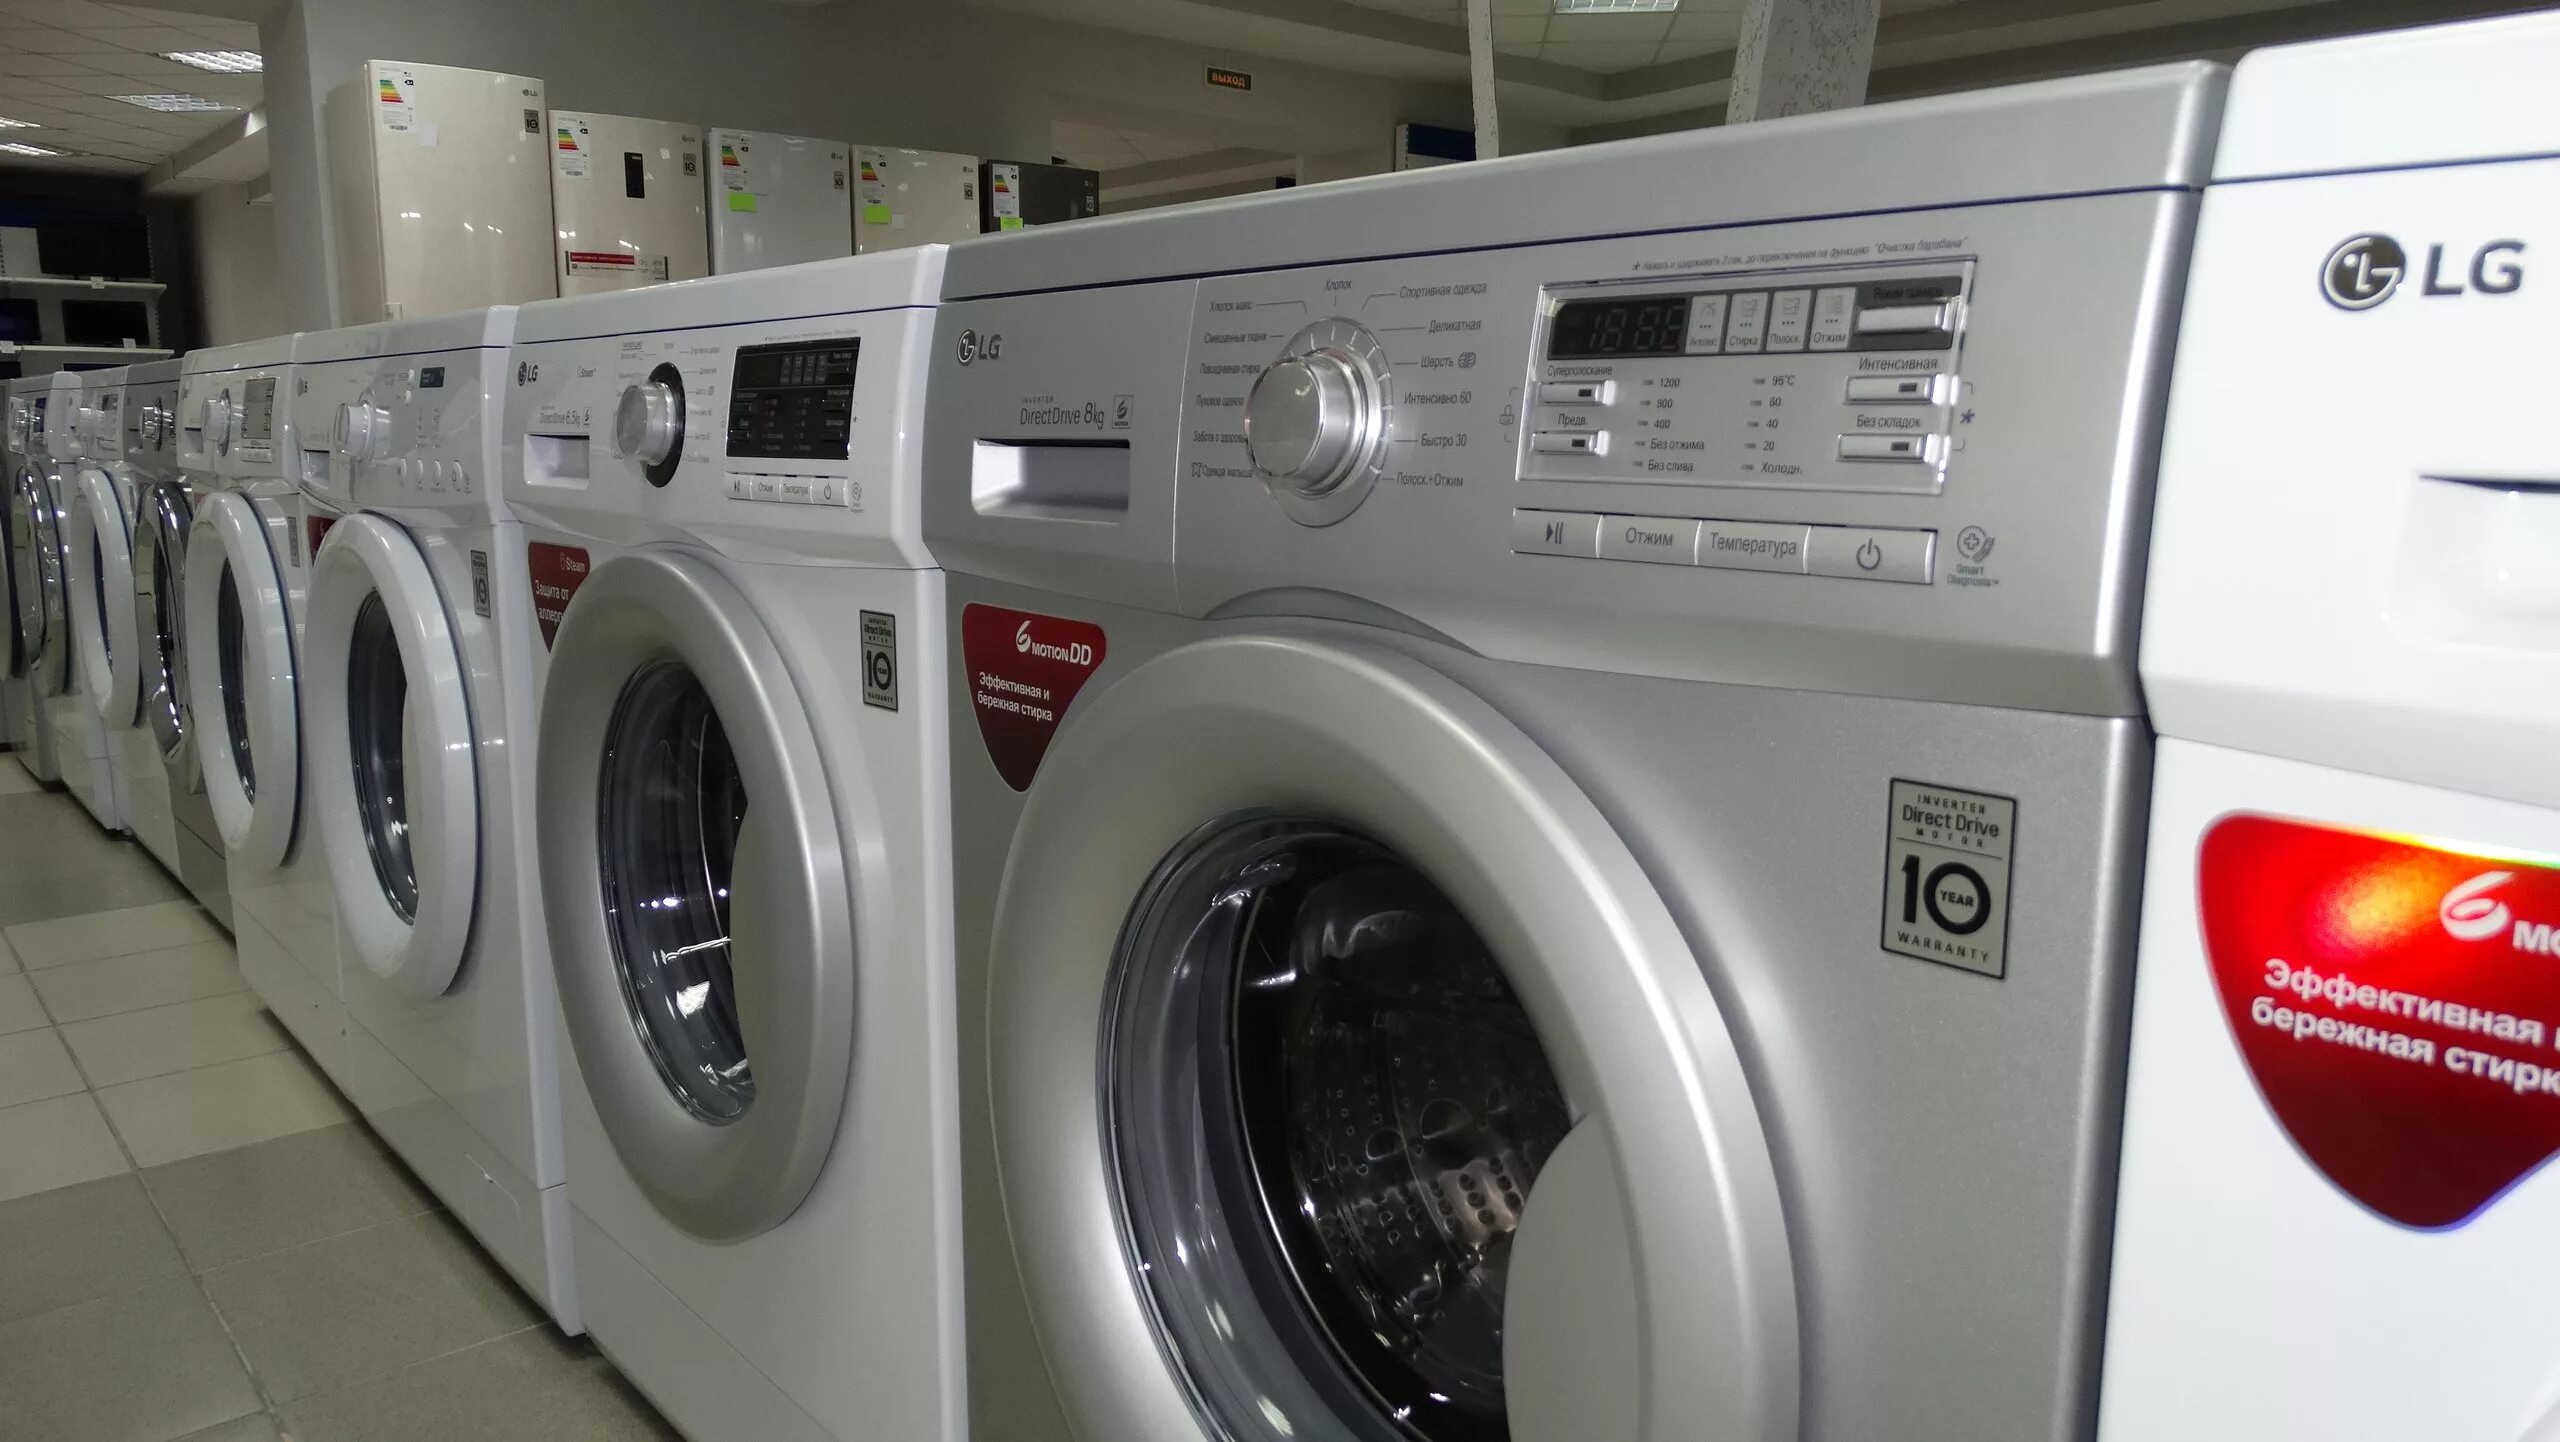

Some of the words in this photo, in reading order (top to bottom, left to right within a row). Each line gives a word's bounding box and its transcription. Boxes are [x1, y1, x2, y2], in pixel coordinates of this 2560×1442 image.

[1212, 72, 1245, 88] ВЫХОД
[2421, 238, 2528, 297] LG
[1325, 278, 1353, 291] Хлопок
[1400, 284, 1451, 301] Спортивная
[1452, 282, 1487, 297] одежда
[1427, 319, 1482, 335] Деликатная
[1729, 335, 1758, 347] Стирка
[1813, 331, 1846, 344] Отжим
[978, 333, 1002, 361] LG
[1420, 354, 1454, 370] Шерсть
[1859, 357, 1938, 371] Интенсивная
[527, 364, 539, 382] LG
[1547, 364, 1613, 378] Суперполоскание
[1659, 377, 1680, 388] 1200
[1403, 391, 1458, 406] Интенсивно
[1459, 390, 1472, 405] 60
[1656, 398, 1673, 409] 800
[1769, 396, 1782, 408] 60
[1083, 401, 1105, 430] 8kg
[1557, 414, 1588, 428] Предв.
[1653, 418, 1670, 429] 400
[1766, 418, 1779, 429] 40
[1857, 414, 1876, 428] Без
[1877, 416, 1921, 429] складок
[1420, 432, 1454, 449] Быстро
[1455, 433, 1468, 447] 30
[1650, 438, 1668, 450] Без
[1668, 439, 1705, 451] отжима
[1763, 440, 1775, 452] 20
[1648, 459, 1665, 471] Без
[1666, 461, 1694, 472] слива
[1760, 461, 1802, 475] Холодн.
[1625, 526, 1674, 547] Отжим
[1710, 531, 1798, 559] Температура
[566, 556, 586, 573] Steam
[535, 579, 560, 600] Защита
[561, 588, 569, 601] от
[866, 650, 892, 691] 10
[979, 670, 1042, 698] Эффективная
[1043, 688, 1050, 701] и
[977, 690, 1020, 714] бережная
[1021, 702, 1053, 722] стирка
[1917, 792, 1986, 815] INVERTER
[1902, 803, 1952, 829] Direct
[1954, 813, 2001, 839] Drive
[1901, 854, 1992, 936] 10
[1939, 888, 1976, 908] YEAR
[1896, 929, 1989, 962] WARRANTY
[2263, 957, 2547, 1047] Эффективная
[2250, 995, 2437, 1065] бережная
